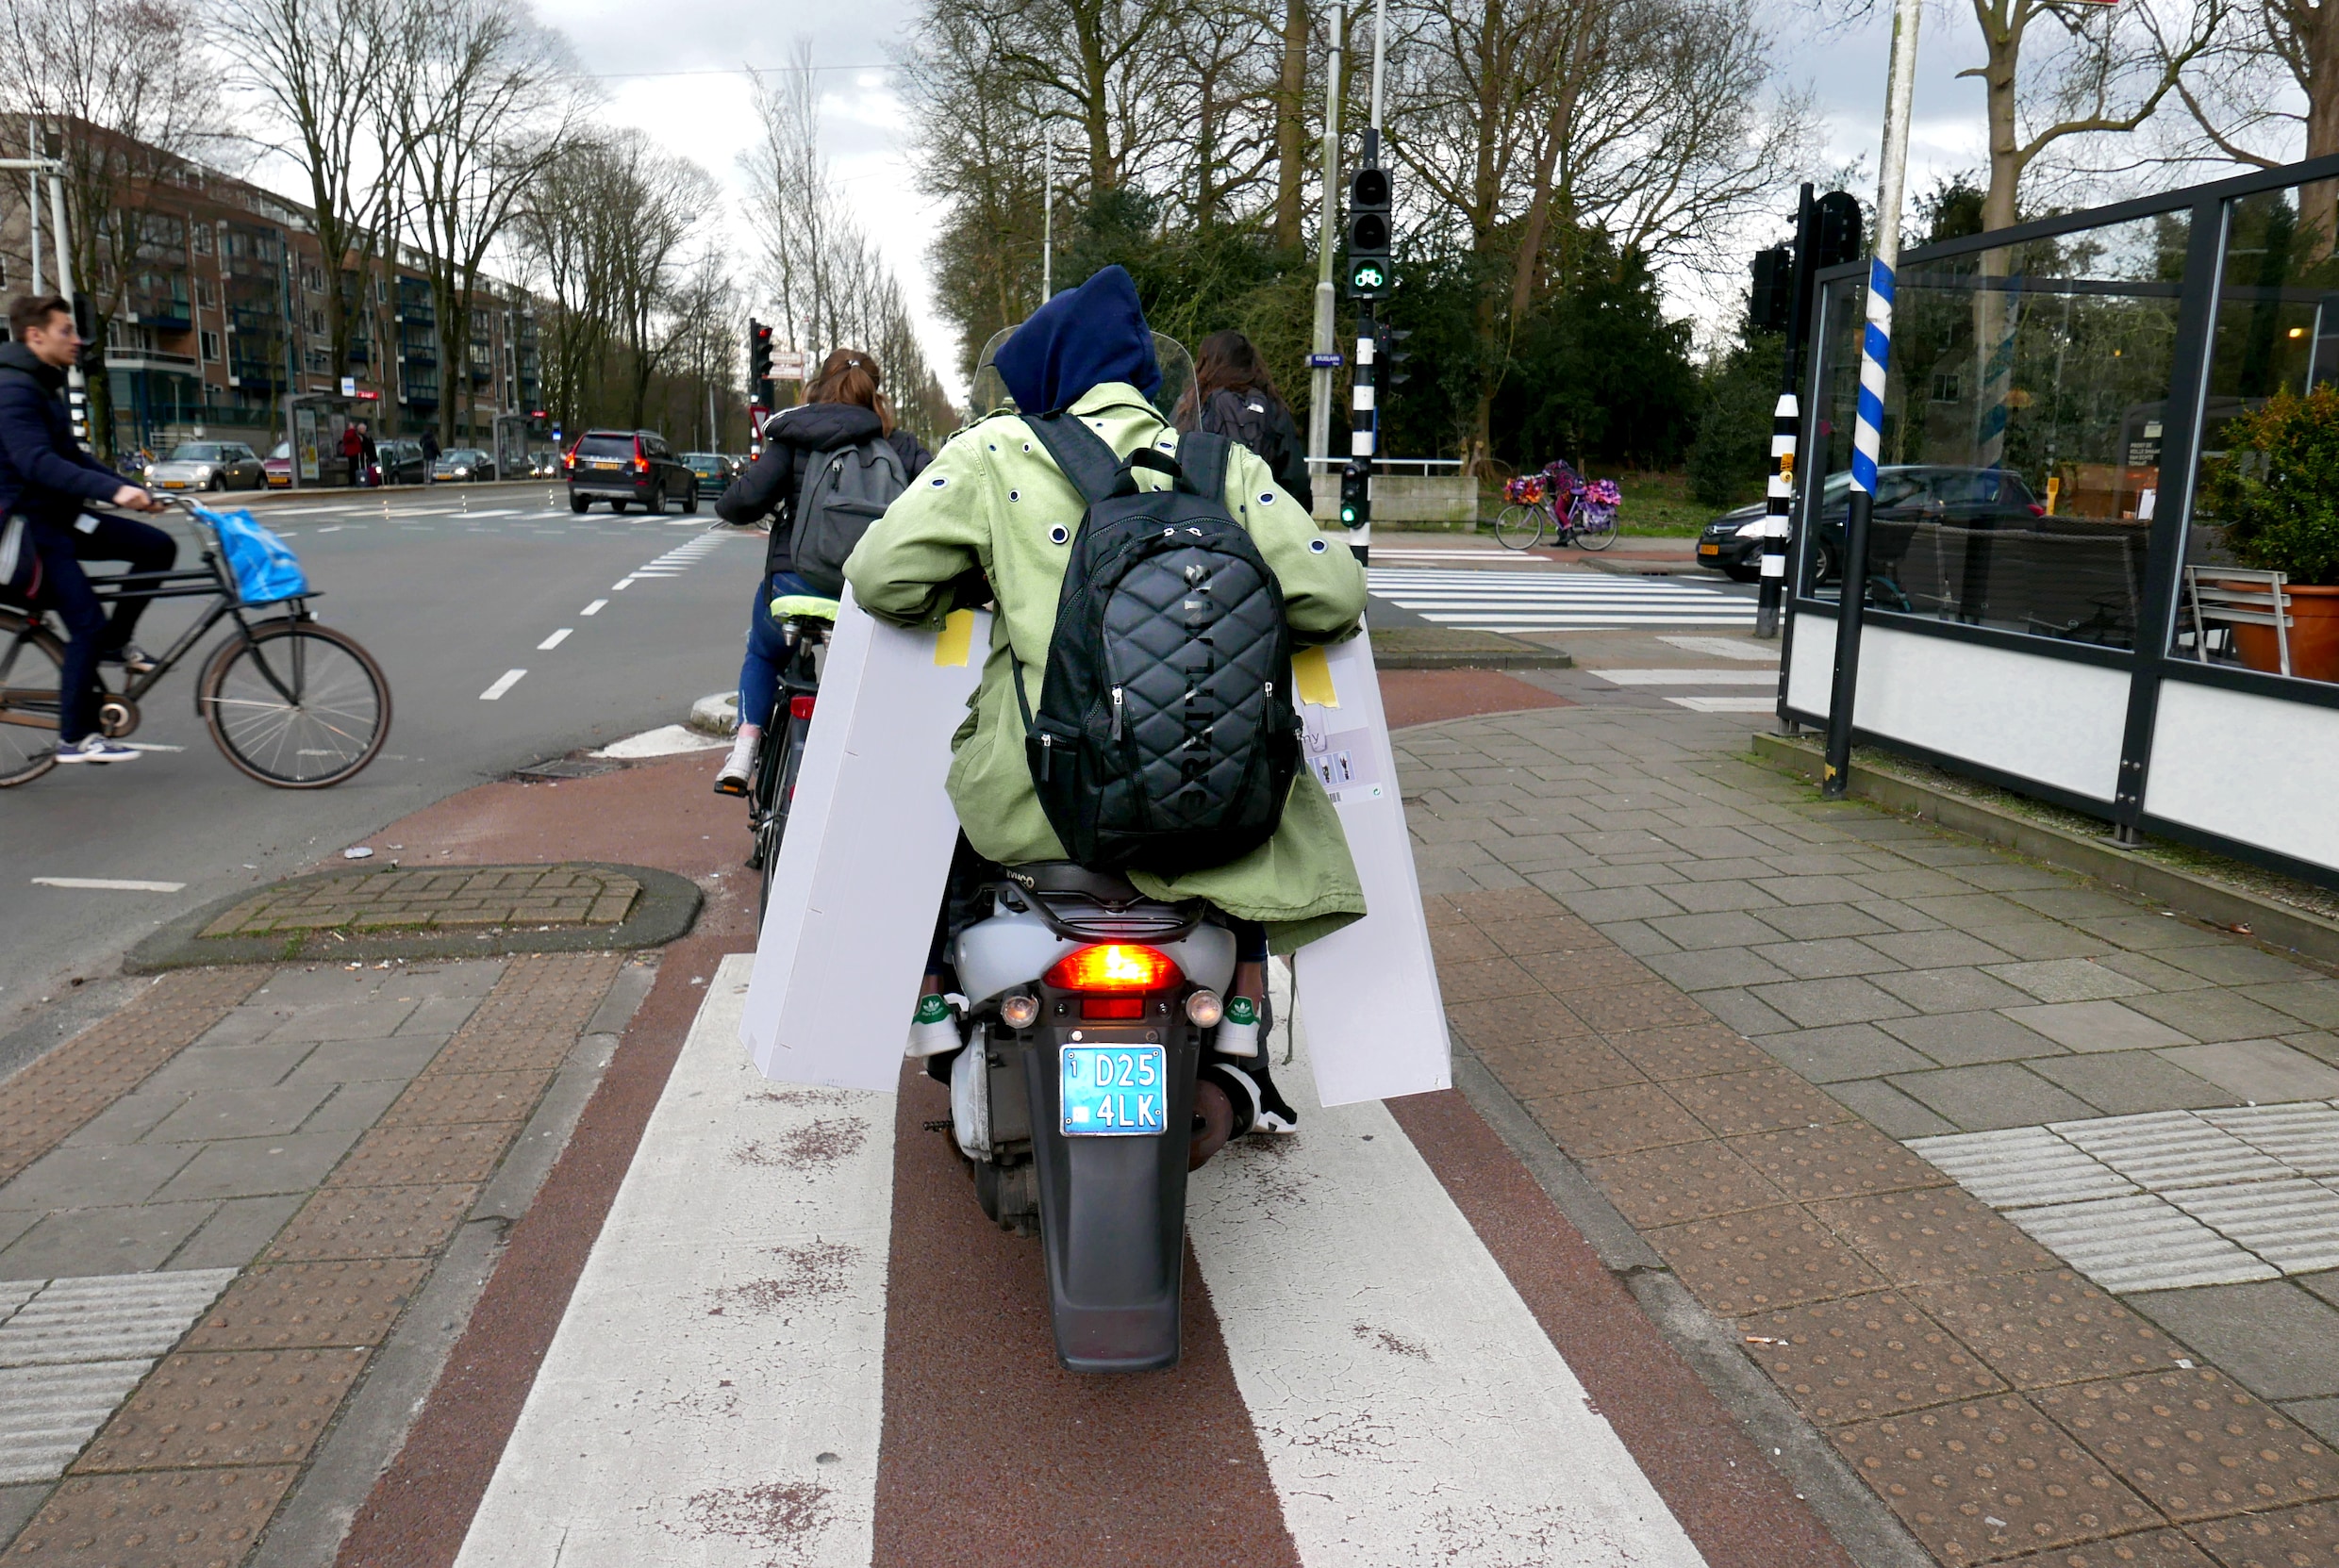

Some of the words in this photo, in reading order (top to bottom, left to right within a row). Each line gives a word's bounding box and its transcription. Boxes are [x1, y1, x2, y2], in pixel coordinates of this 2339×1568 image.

[1070, 1060, 1078, 1078] 1
[1095, 1053, 1156, 1087] D25
[1096, 1094, 1157, 1128] 4LK
